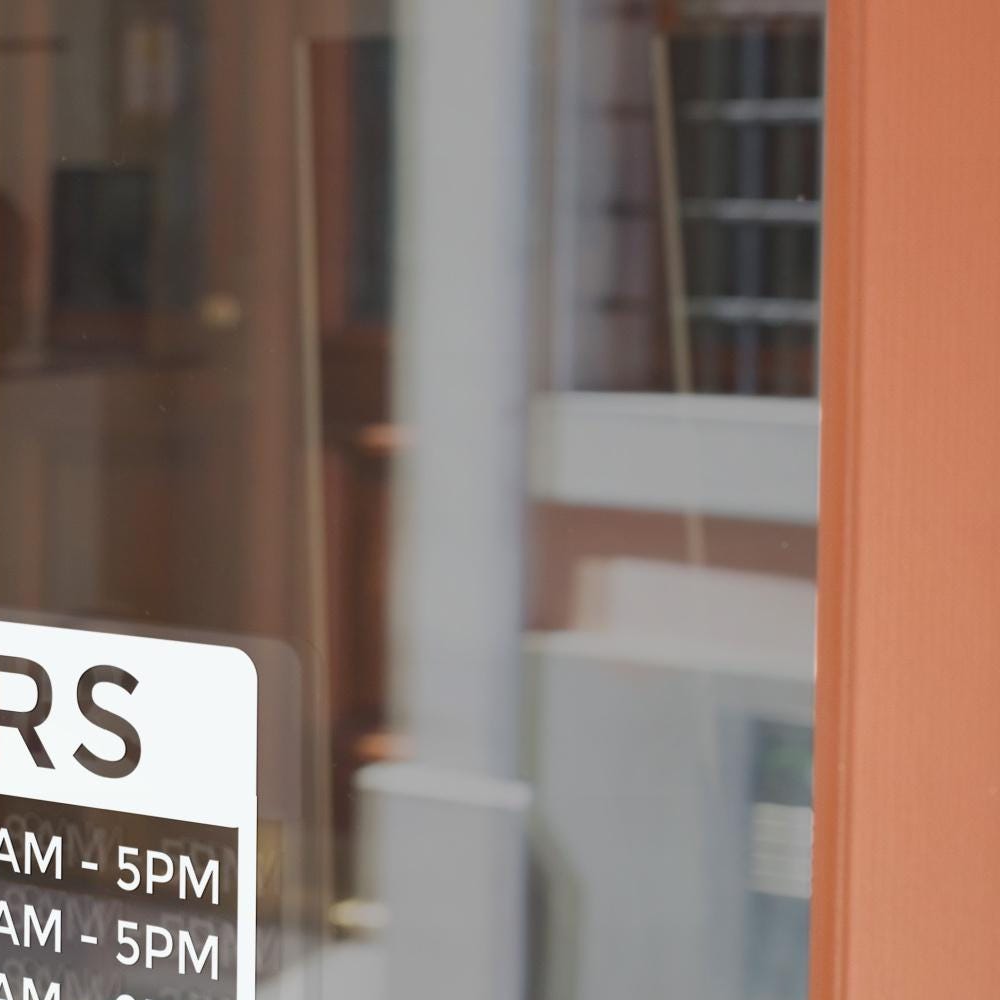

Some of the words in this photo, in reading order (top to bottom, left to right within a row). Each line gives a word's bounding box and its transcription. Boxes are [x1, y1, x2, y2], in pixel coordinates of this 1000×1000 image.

[81, 861, 98, 871] -
[117, 846, 219, 905] 5PM
[80, 934, 98, 945] -
[116, 919, 219, 980] 5PM
